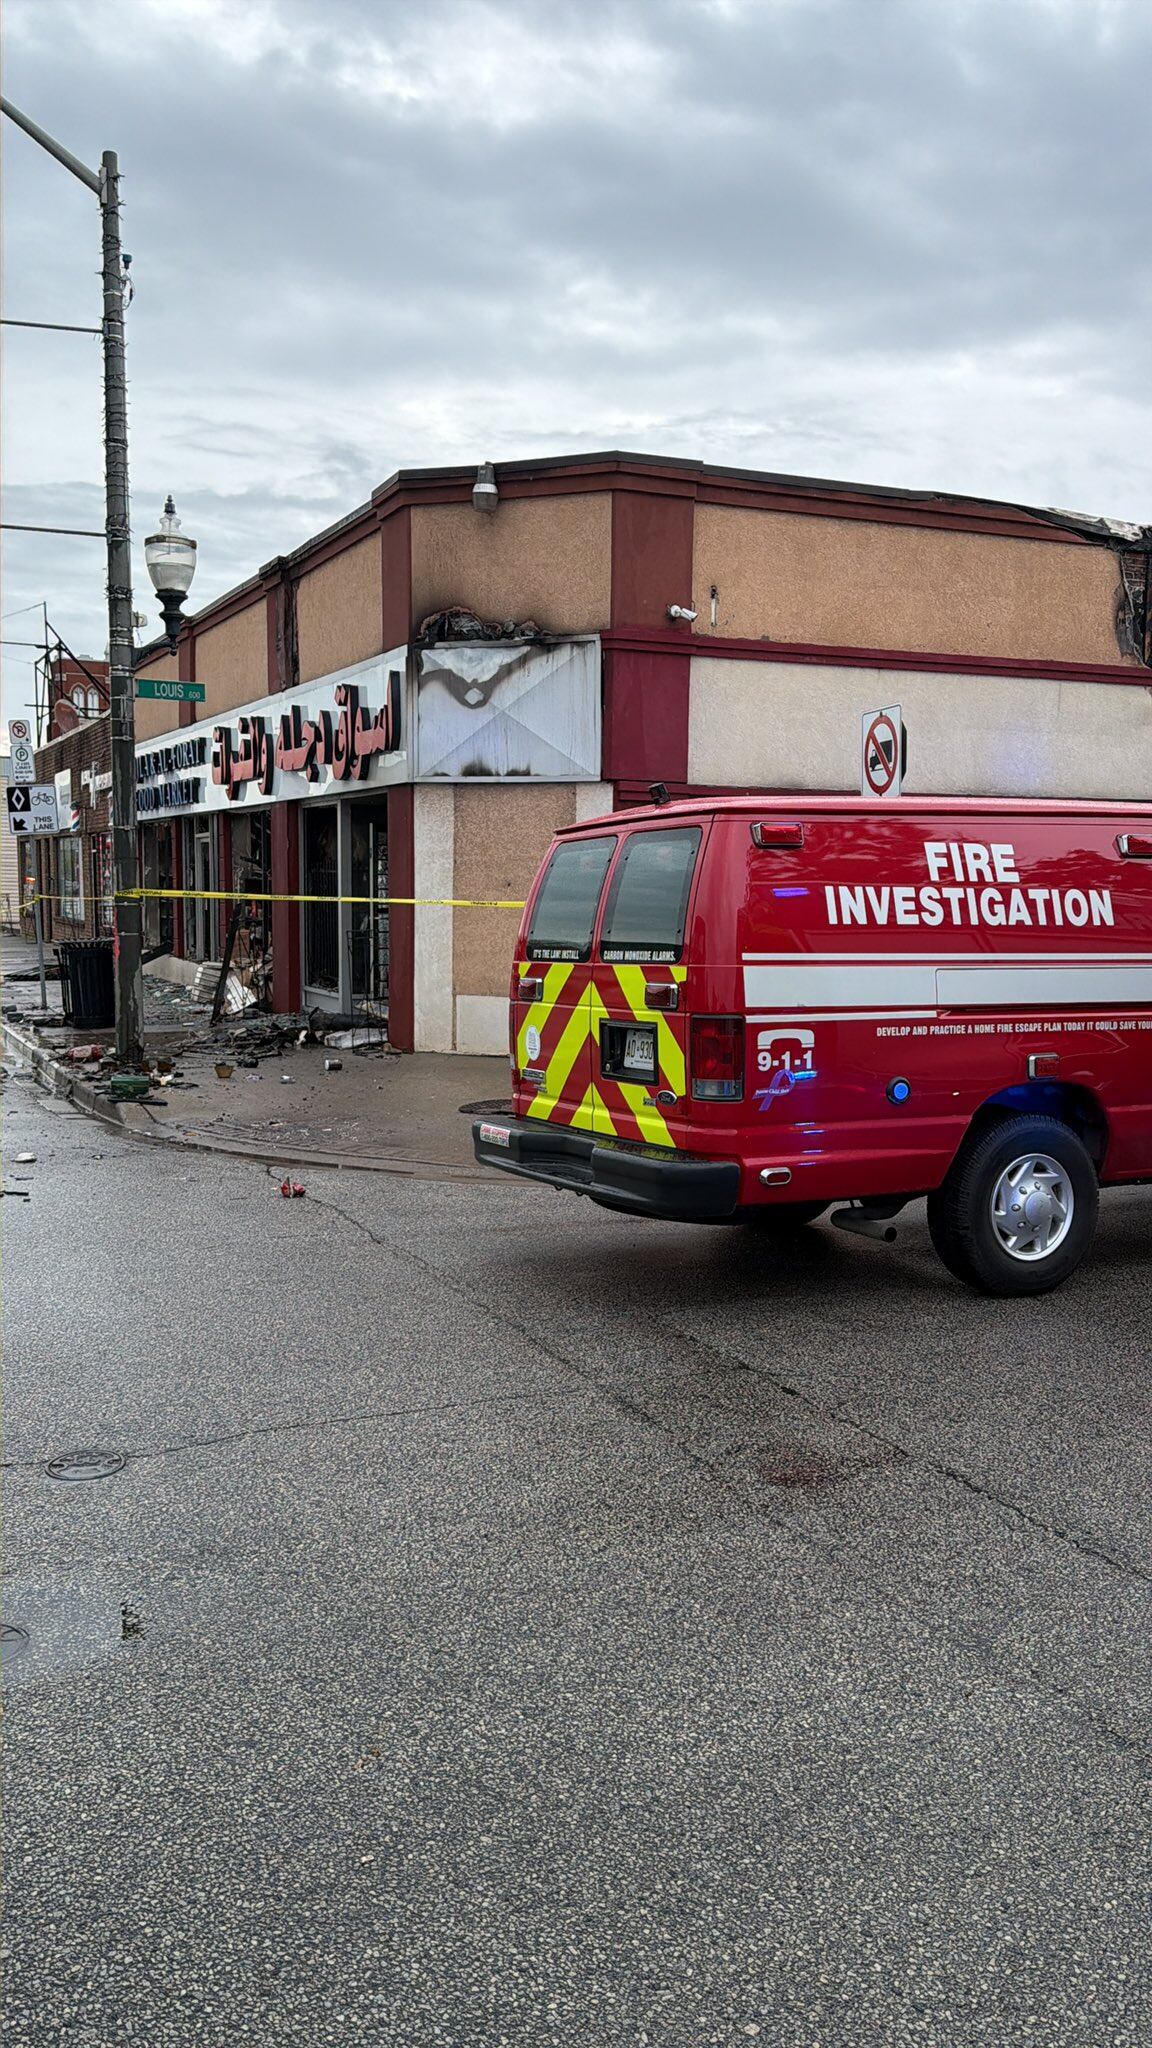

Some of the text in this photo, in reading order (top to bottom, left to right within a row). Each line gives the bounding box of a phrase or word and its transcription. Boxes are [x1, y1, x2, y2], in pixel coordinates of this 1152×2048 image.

[154, 682, 184, 698] LOUIS
[136, 776, 198, 812] OOD MARKET
[33, 815, 53, 823] THIS
[33, 822, 54, 831] LANE
[924, 841, 1020, 882] FIRE
[824, 885, 1115, 926] INVESTIGATION
[533, 949, 541, 958] IT'S
[542, 949, 550, 958] THE
[561, 950, 579, 959] INSTALL
[603, 950, 624, 960] CARBON
[624, 951, 651, 960] MONOXIDE
[876, 1027, 910, 1036] DEVELOP
[912, 1026, 928, 1035] AND
[929, 1025, 966, 1035] PRACTICE
[967, 1025, 973, 1034] A
[974, 1024, 995, 1033] HOME
[997, 1023, 1013, 1033] FIRE
[1015, 1022, 1042, 1032] ESCAPE
[1043, 1022, 1062, 1032] PLAN
[1063, 1021, 1086, 1031] TODAY
[1086, 1021, 1094, 1031] IT
[1095, 1021, 1118, 1031] COULD
[1119, 1020, 1136, 1030] SAVE
[757, 1050, 812, 1072] 9-1-1
